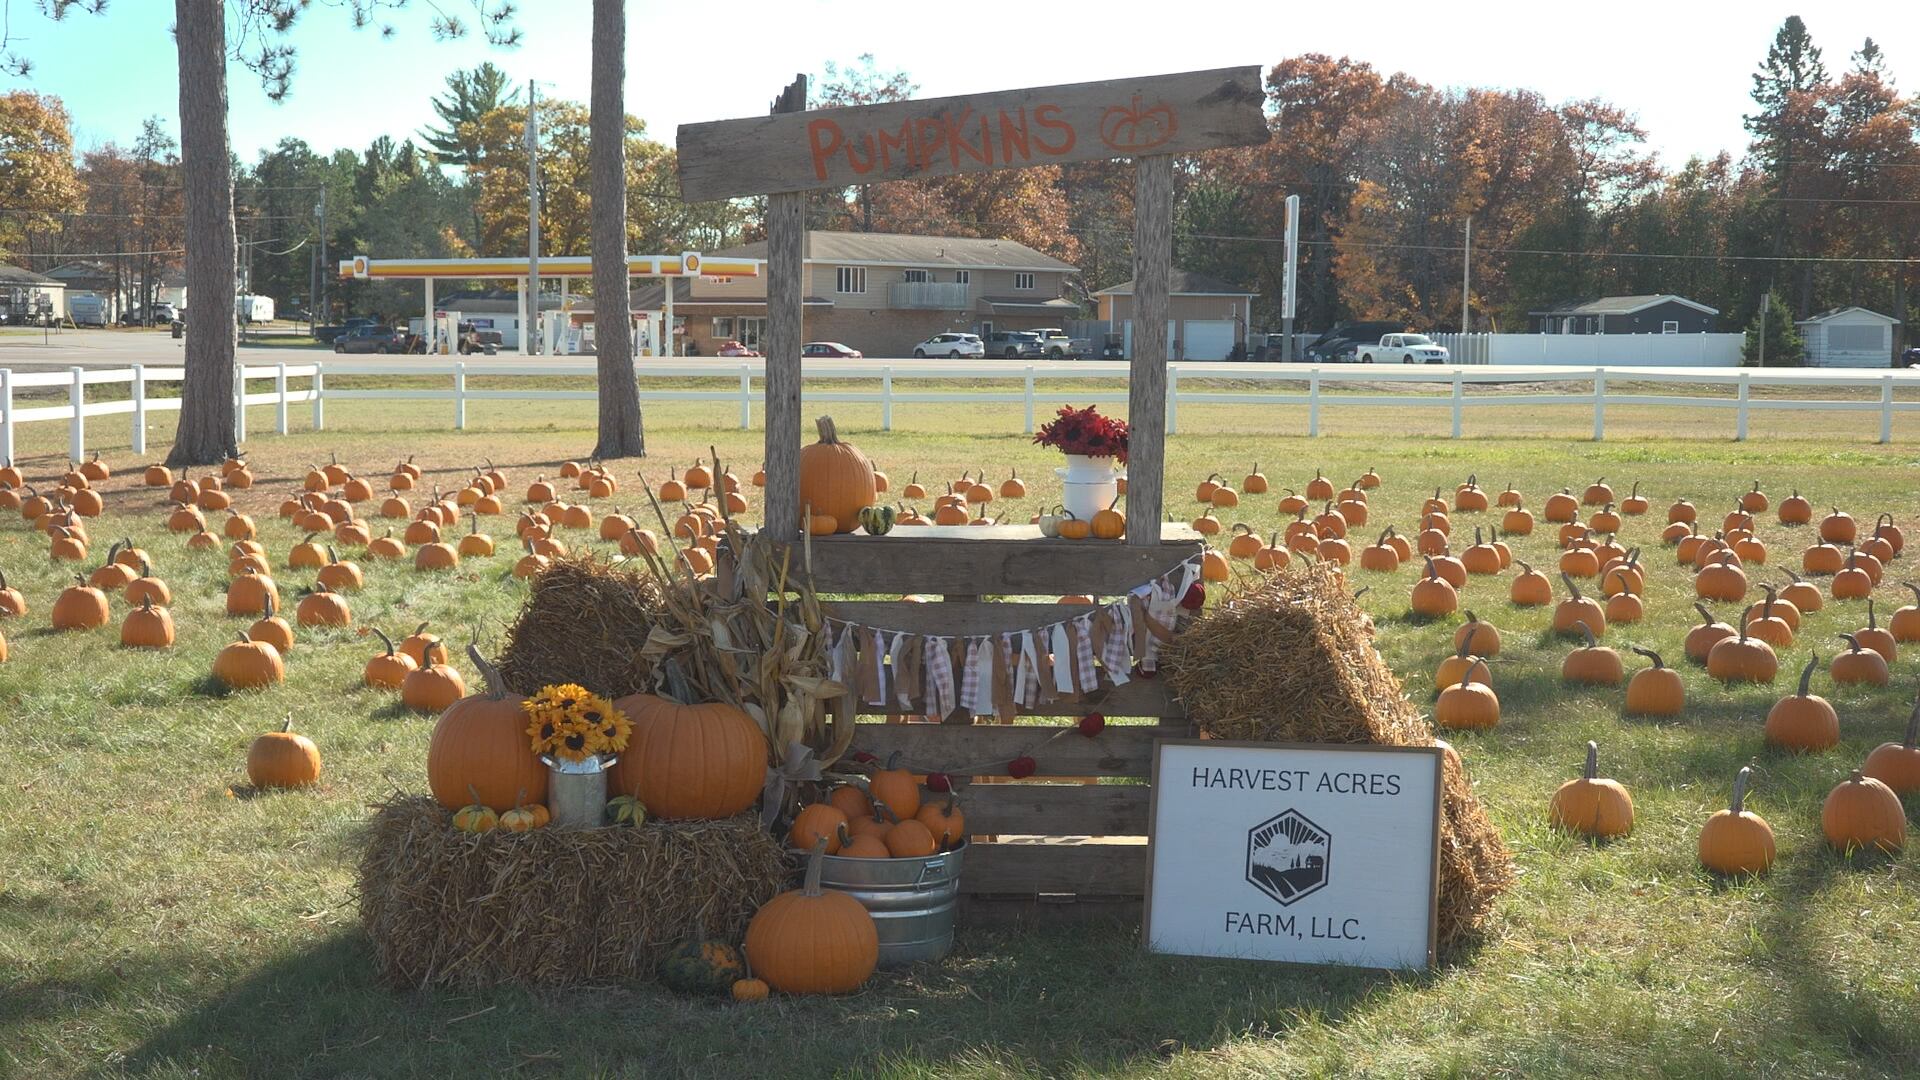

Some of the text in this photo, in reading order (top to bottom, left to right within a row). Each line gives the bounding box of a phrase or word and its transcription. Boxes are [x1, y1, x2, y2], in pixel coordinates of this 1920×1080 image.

[808, 106, 1076, 182] PUMPKINS
[1192, 766, 1401, 796] HARVEST ACRES
[1225, 911, 1366, 941] FARM, LLC.
